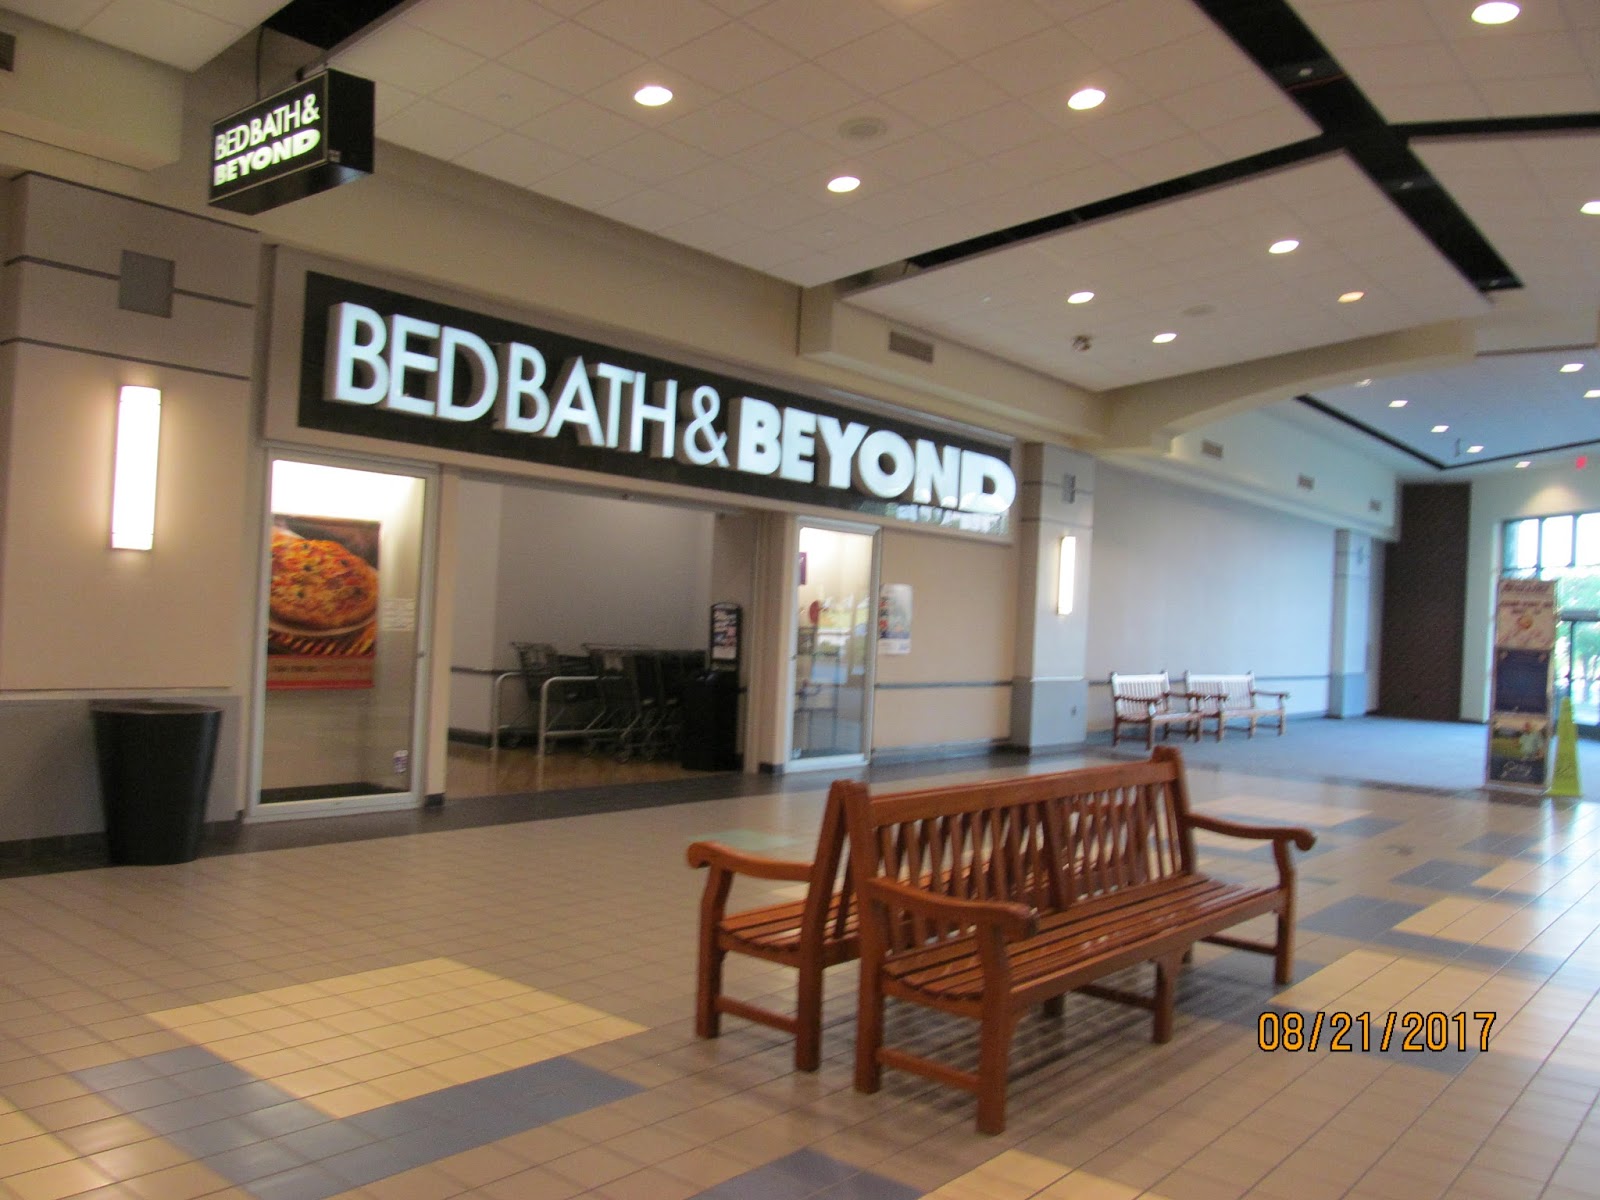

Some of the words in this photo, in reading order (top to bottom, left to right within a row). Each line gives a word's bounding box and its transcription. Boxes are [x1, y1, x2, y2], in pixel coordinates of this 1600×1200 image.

[213, 128, 321, 186] BEYOND
[214, 124, 250, 161] BED
[250, 99, 301, 147] BATH
[301, 93, 320, 125] &
[332, 301, 499, 422] BED
[503, 341, 679, 459] BATH
[683, 385, 730, 468] &
[736, 396, 1017, 515] BEYOND
